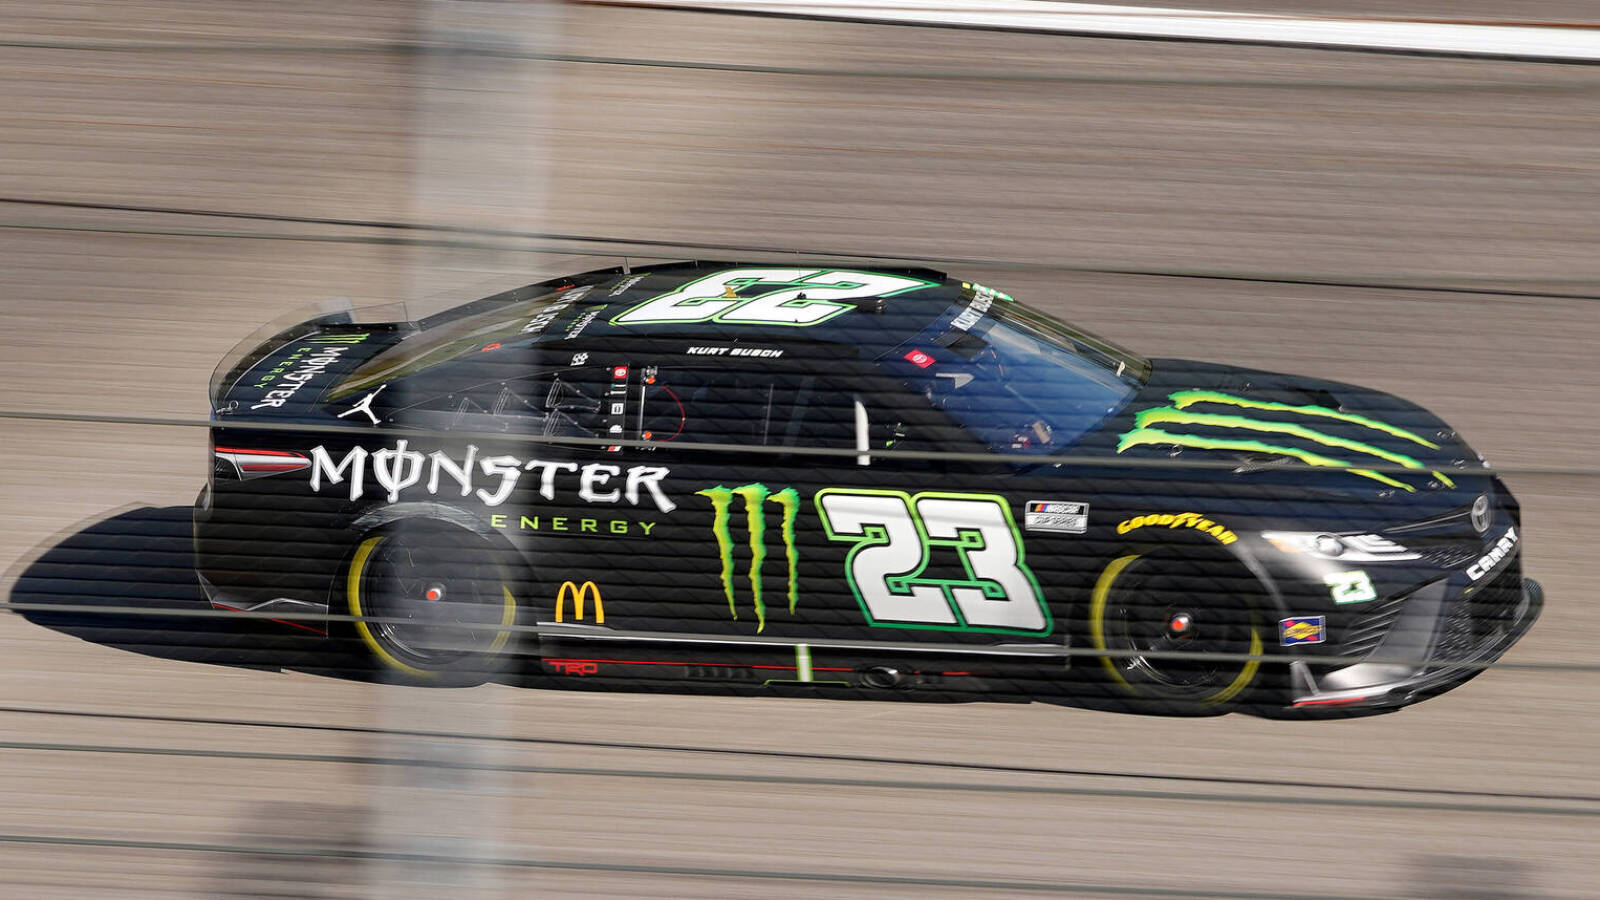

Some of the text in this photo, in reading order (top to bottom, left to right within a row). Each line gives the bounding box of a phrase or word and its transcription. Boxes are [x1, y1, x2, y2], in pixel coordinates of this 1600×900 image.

[254, 347, 312, 389] ENERGY
[687, 346, 783, 358] KURT BUSCH
[490, 514, 657, 536] ENERGY
[1116, 512, 1239, 545] GOODYEAR
[814, 487, 1053, 638] 23
[1322, 570, 1377, 605] 23
[549, 661, 598, 676] TRD
